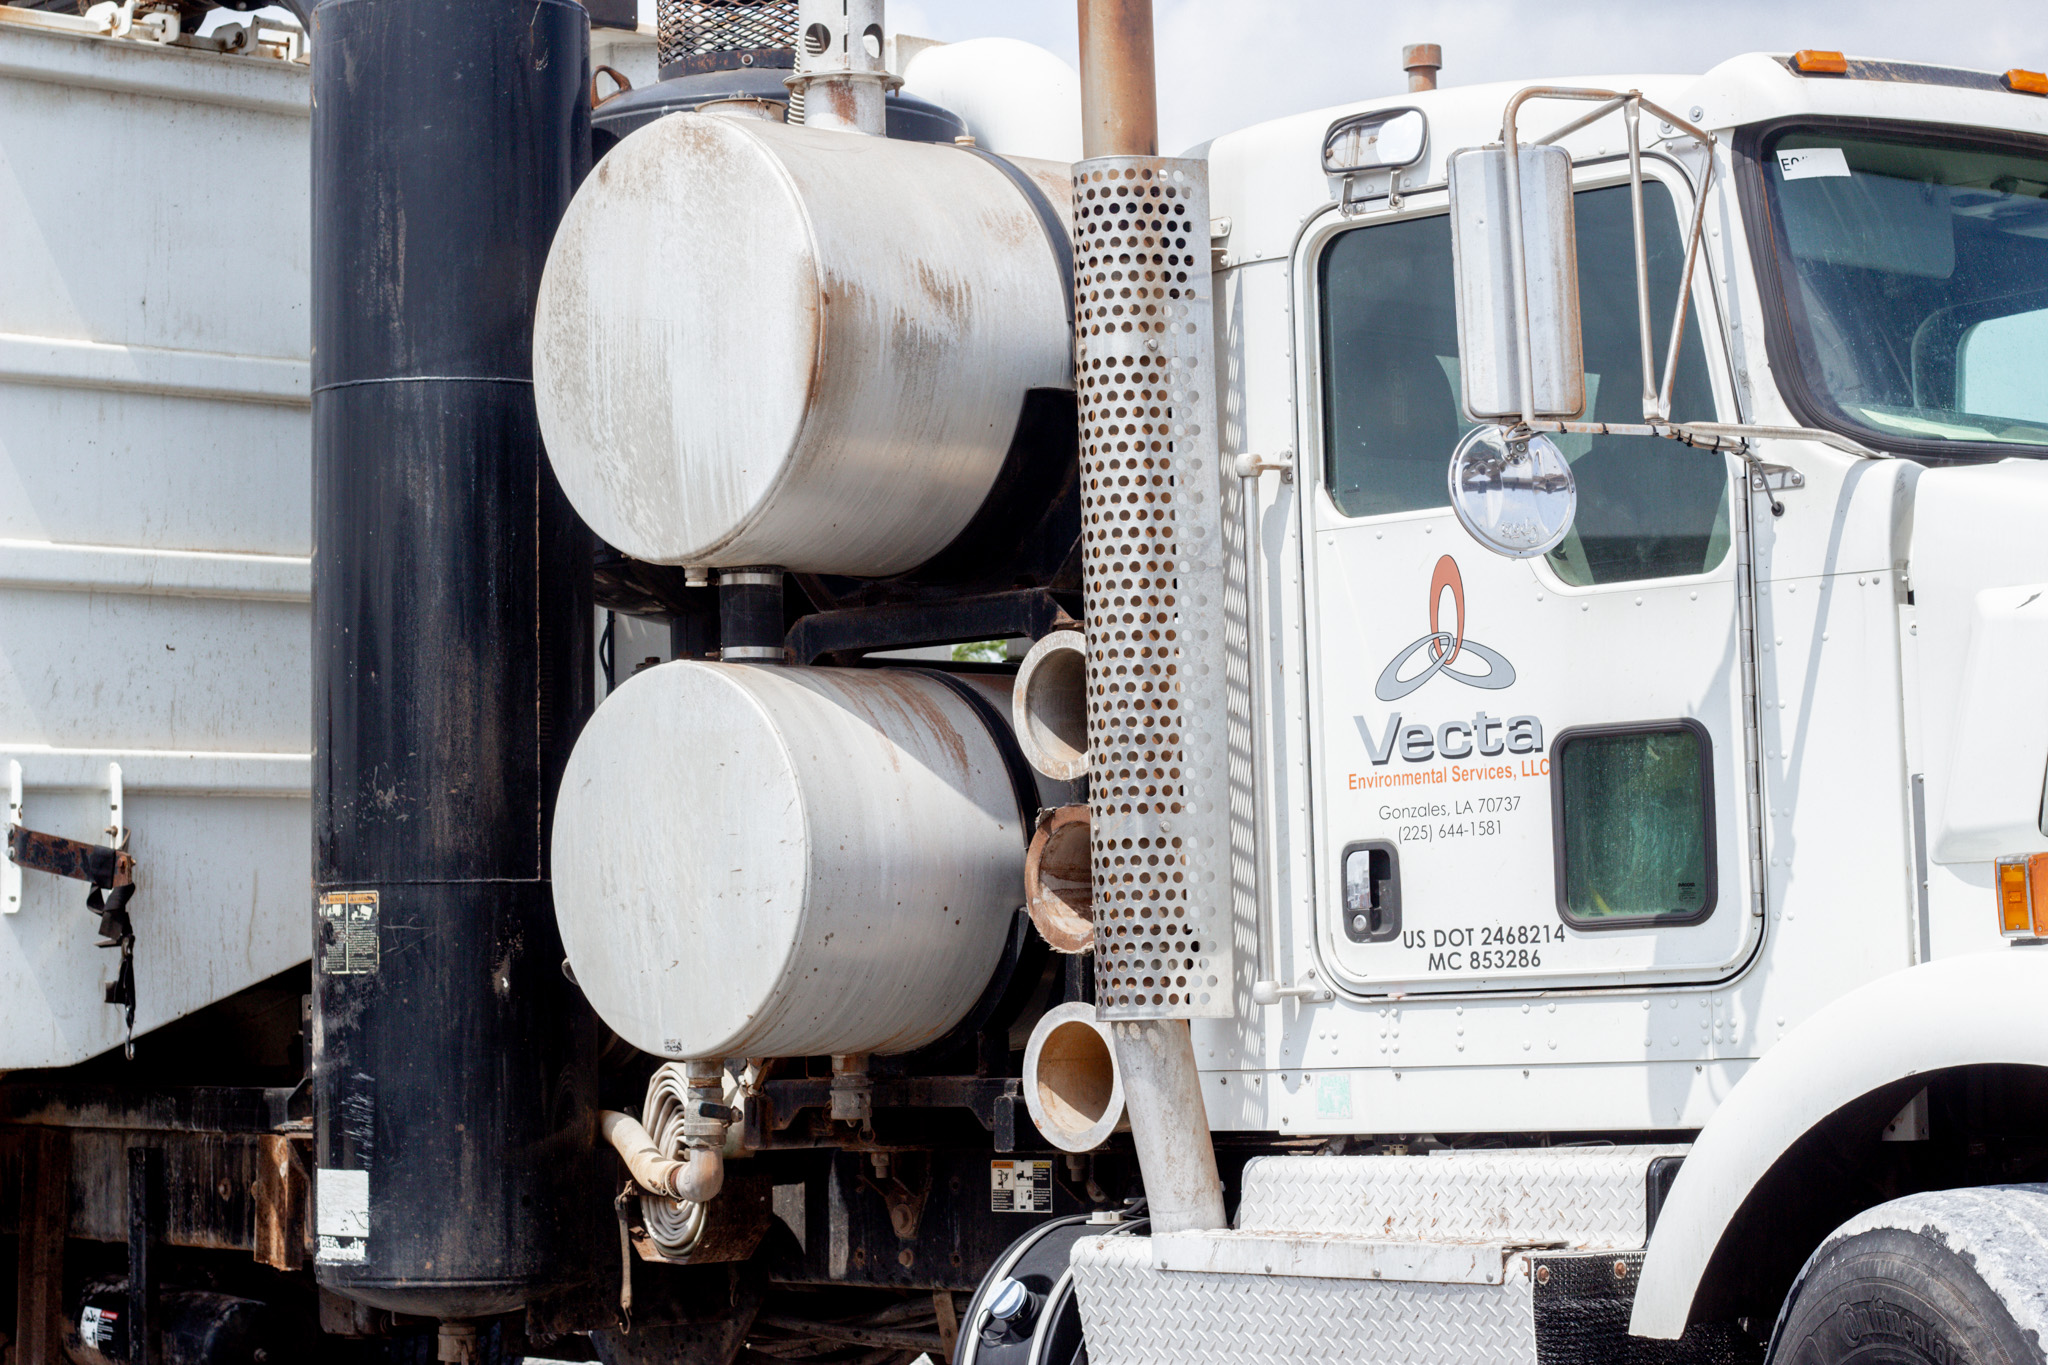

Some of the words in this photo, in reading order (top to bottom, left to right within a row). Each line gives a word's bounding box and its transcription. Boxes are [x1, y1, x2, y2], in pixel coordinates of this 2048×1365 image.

[1353, 711, 1544, 766] Vecta
[1348, 767, 1447, 790] Environmental
[1451, 763, 1517, 783] Services,
[1521, 758, 1550, 777] LLC
[1379, 801, 1450, 820] Gonzales,
[1455, 800, 1474, 815] LA
[1478, 796, 1521, 814] 70737
[1398, 825, 1433, 844] (225)
[1438, 820, 1501, 839] 644-1581
[1403, 930, 1426, 949] US
[1433, 928, 1474, 947] DOT
[1481, 924, 1565, 946] 2468214
[1428, 952, 1462, 971] MC
[1469, 949, 1541, 970] 853286
